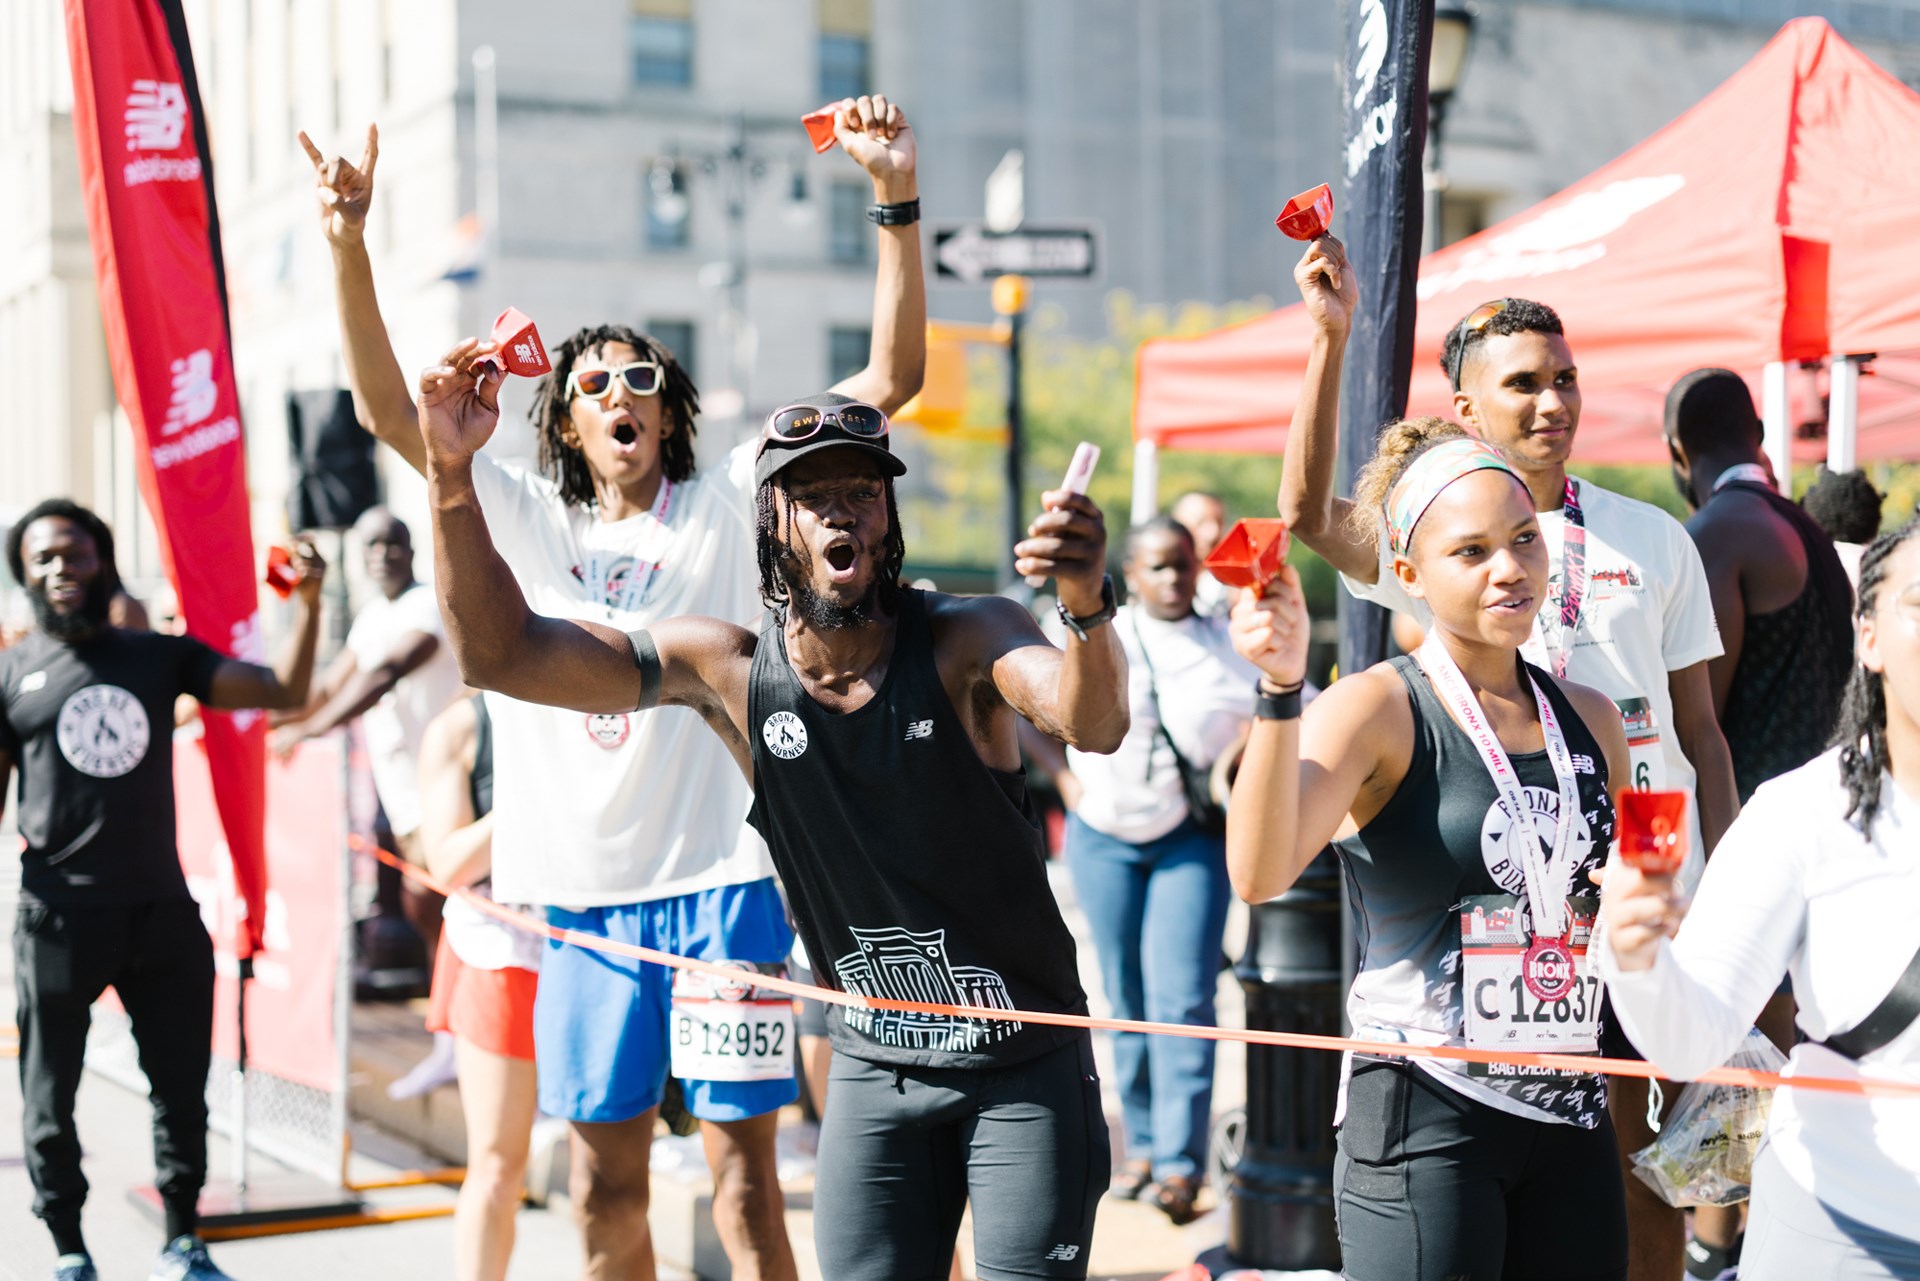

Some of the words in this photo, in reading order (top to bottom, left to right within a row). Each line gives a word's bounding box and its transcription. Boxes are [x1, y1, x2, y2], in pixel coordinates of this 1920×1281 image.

[527, 335, 540, 356] balance
[767, 713, 796, 729] BRONX
[1541, 702, 1556, 730] MILE
[904, 719, 934, 741] NB
[1456, 692, 1483, 732] BRONX
[1478, 731, 1492, 748] 10
[1485, 748, 1509, 777] MILE
[770, 738, 807, 759] BURNERS
[1529, 960, 1571, 980] BRONX
[1474, 978, 1500, 1020] C
[679, 1017, 693, 1046] B
[702, 1021, 785, 1057] 12952
[1044, 1243, 1080, 1261] NB
